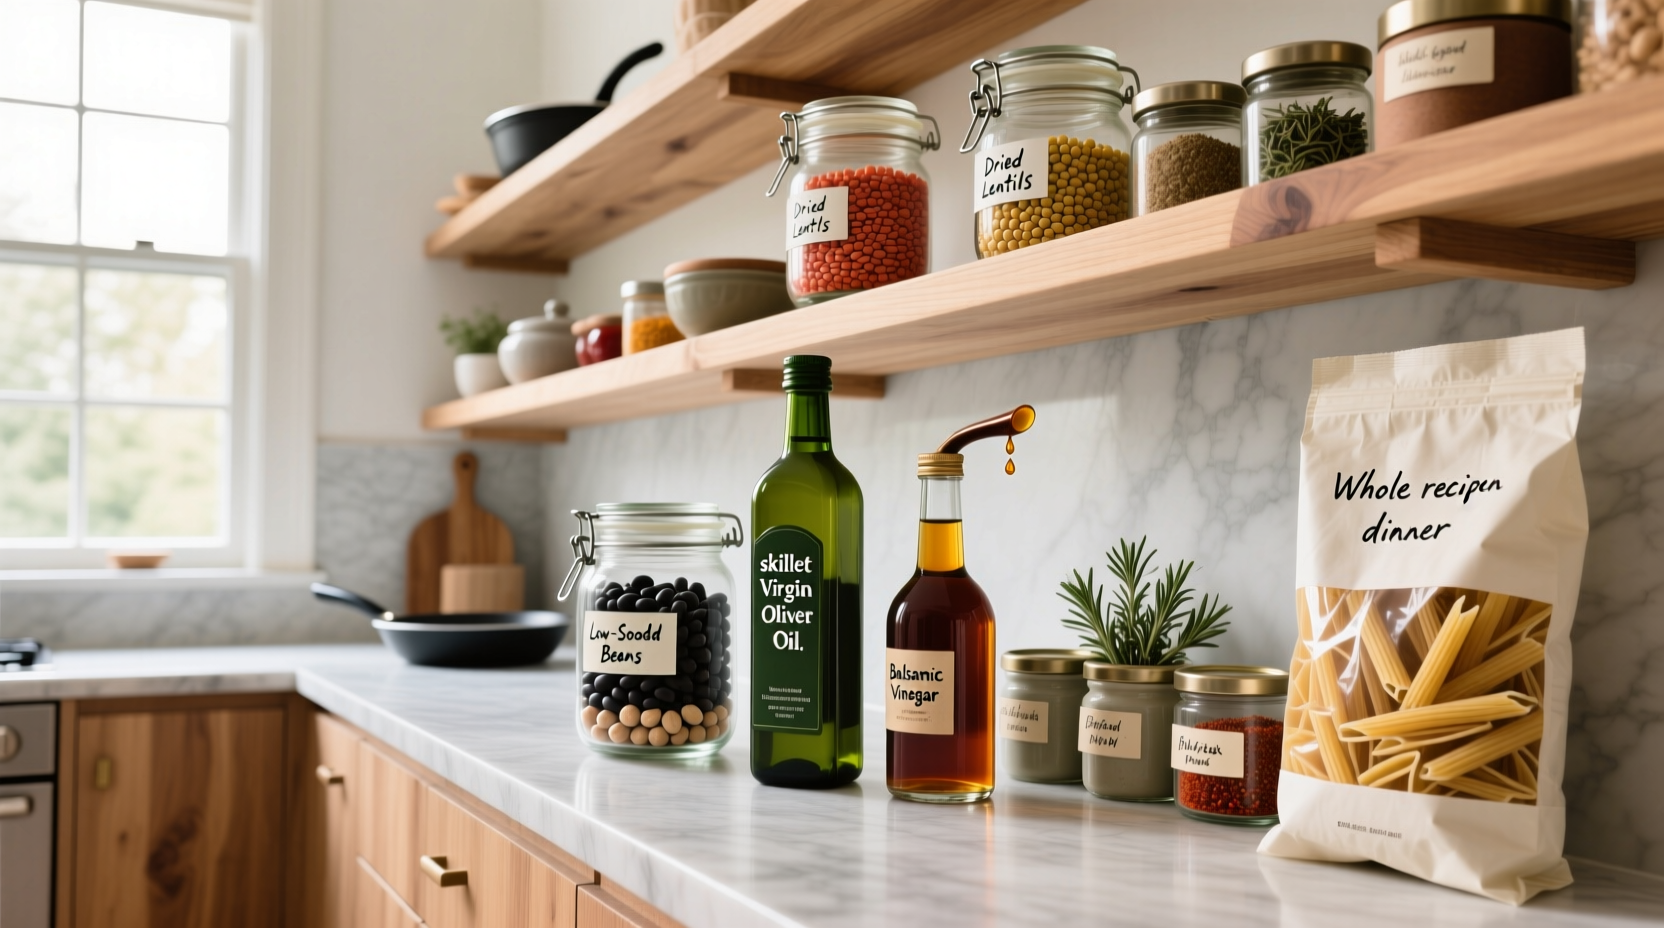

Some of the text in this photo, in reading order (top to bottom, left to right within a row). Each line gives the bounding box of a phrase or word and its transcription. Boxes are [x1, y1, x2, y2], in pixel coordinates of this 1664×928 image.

[983, 147, 1024, 177] Dried
[982, 171, 1033, 198] Lentils
[794, 194, 827, 219] Dried
[1334, 468, 1411, 501] Whole
[1361, 511, 1452, 544] dinner
[759, 553, 813, 574] skillet
[759, 578, 813, 603] Virgin
[761, 605, 814, 624] Oliver
[772, 630, 804, 652] Oil.
[890, 683, 940, 707] Vinegar
